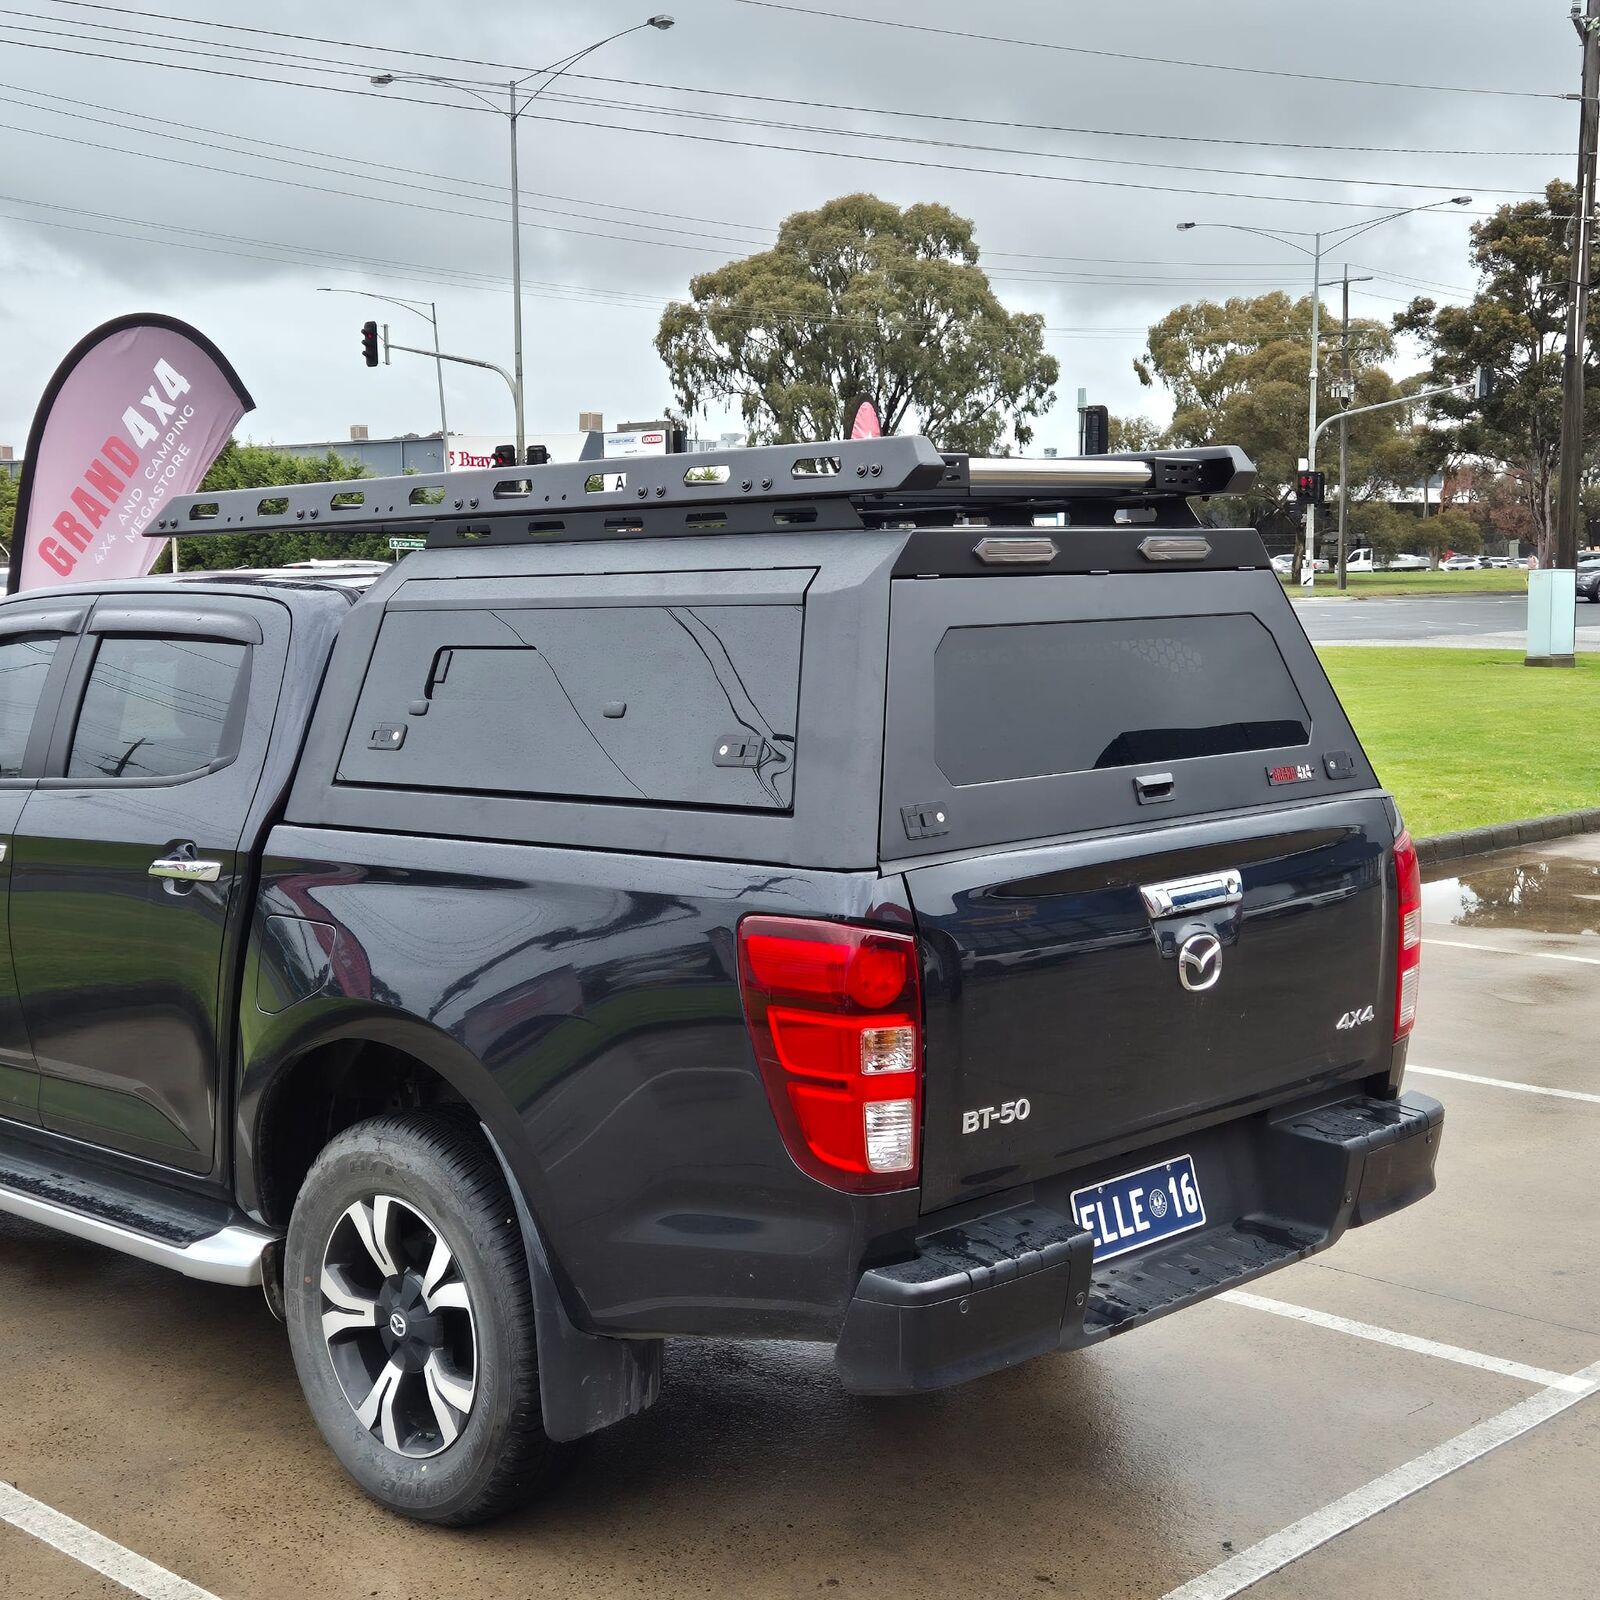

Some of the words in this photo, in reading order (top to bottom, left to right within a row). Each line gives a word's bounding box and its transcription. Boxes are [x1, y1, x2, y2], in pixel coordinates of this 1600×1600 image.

[38, 435, 140, 577] GRAND
[118, 488, 143, 526] AND
[144, 404, 195, 481] CAMPING
[124, 443, 191, 544] MEGASTORE
[615, 475, 625, 491] A
[962, 1098, 1031, 1134] BT-50
[1079, 1187, 1151, 1248] ELLE
[1168, 1172, 1198, 1218] 16
